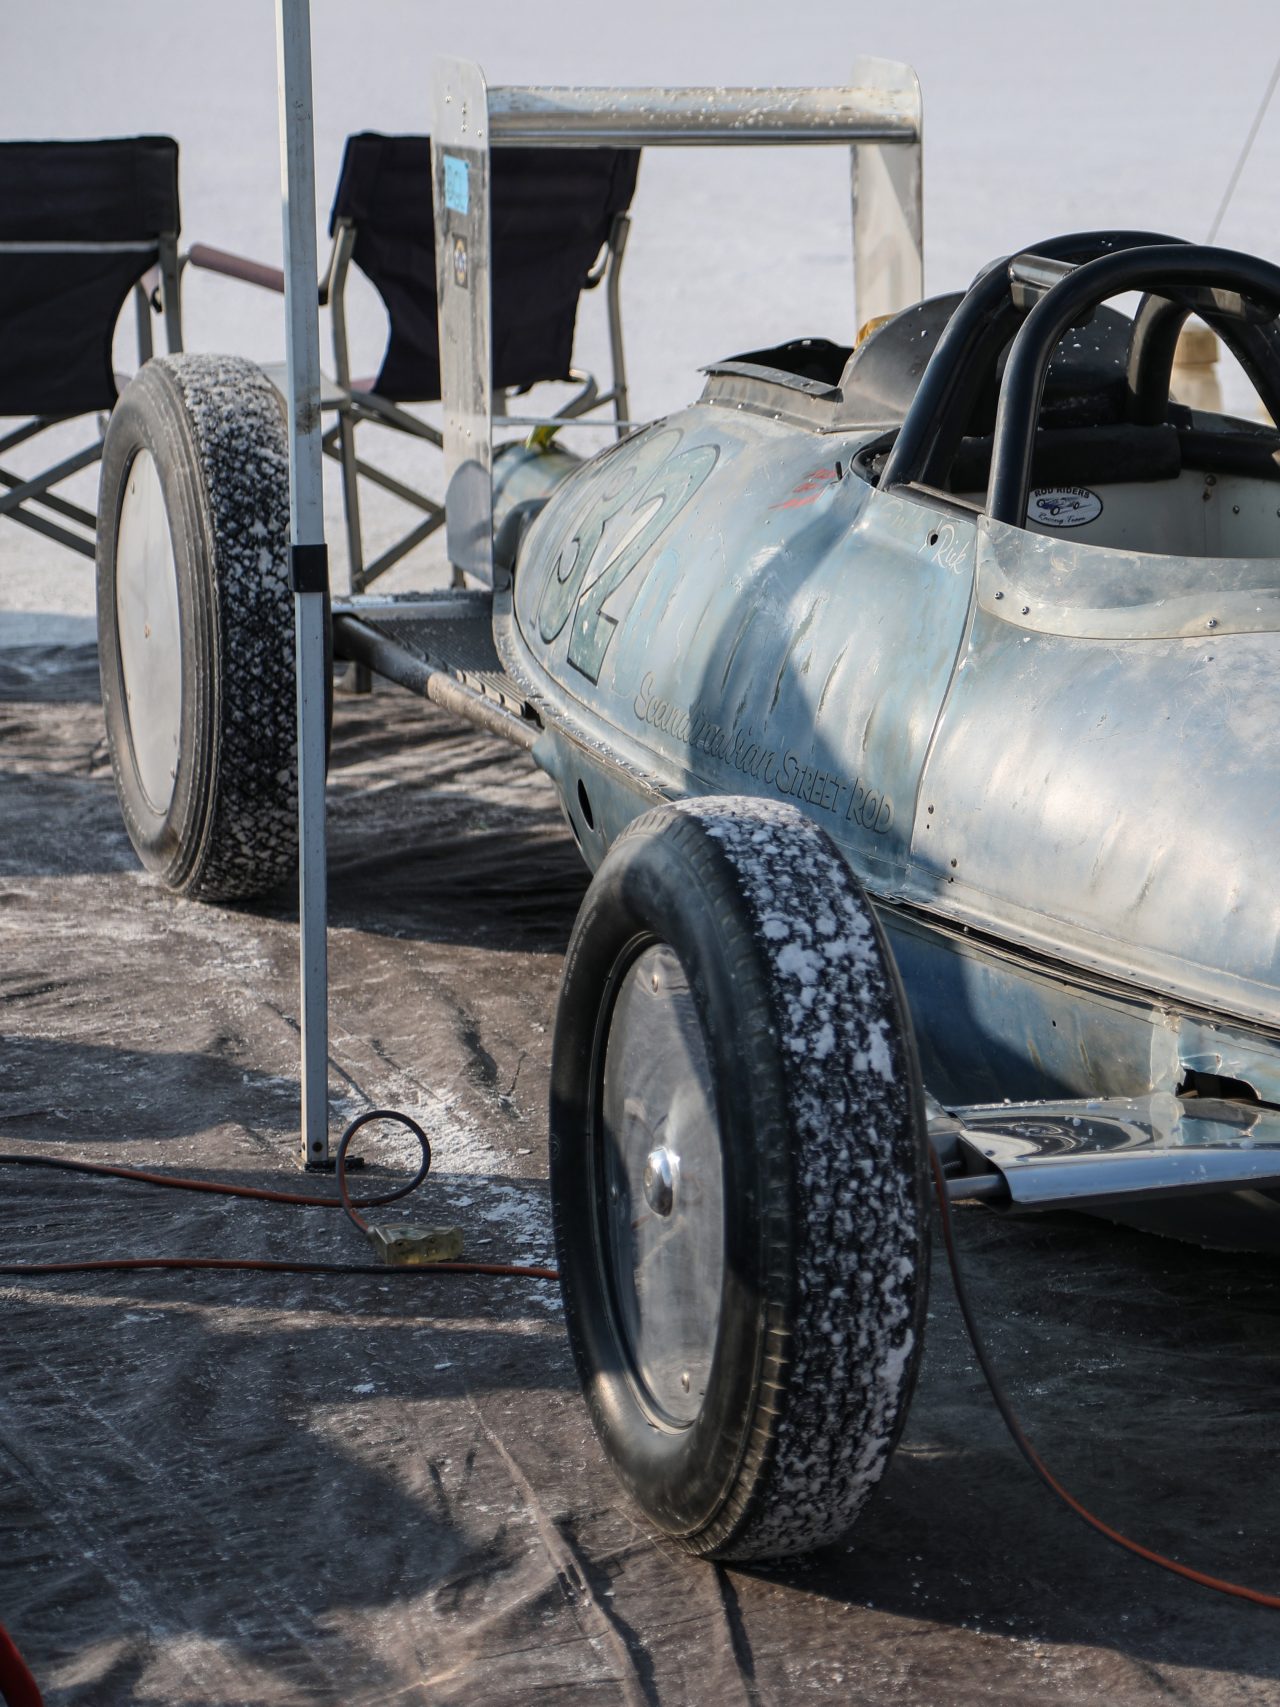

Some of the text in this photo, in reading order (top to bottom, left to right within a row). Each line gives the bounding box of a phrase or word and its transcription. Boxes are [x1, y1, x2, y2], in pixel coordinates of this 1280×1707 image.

[1034, 487, 1090, 499] ROD RIDERS
[633, 670, 775, 784] Scandinavian
